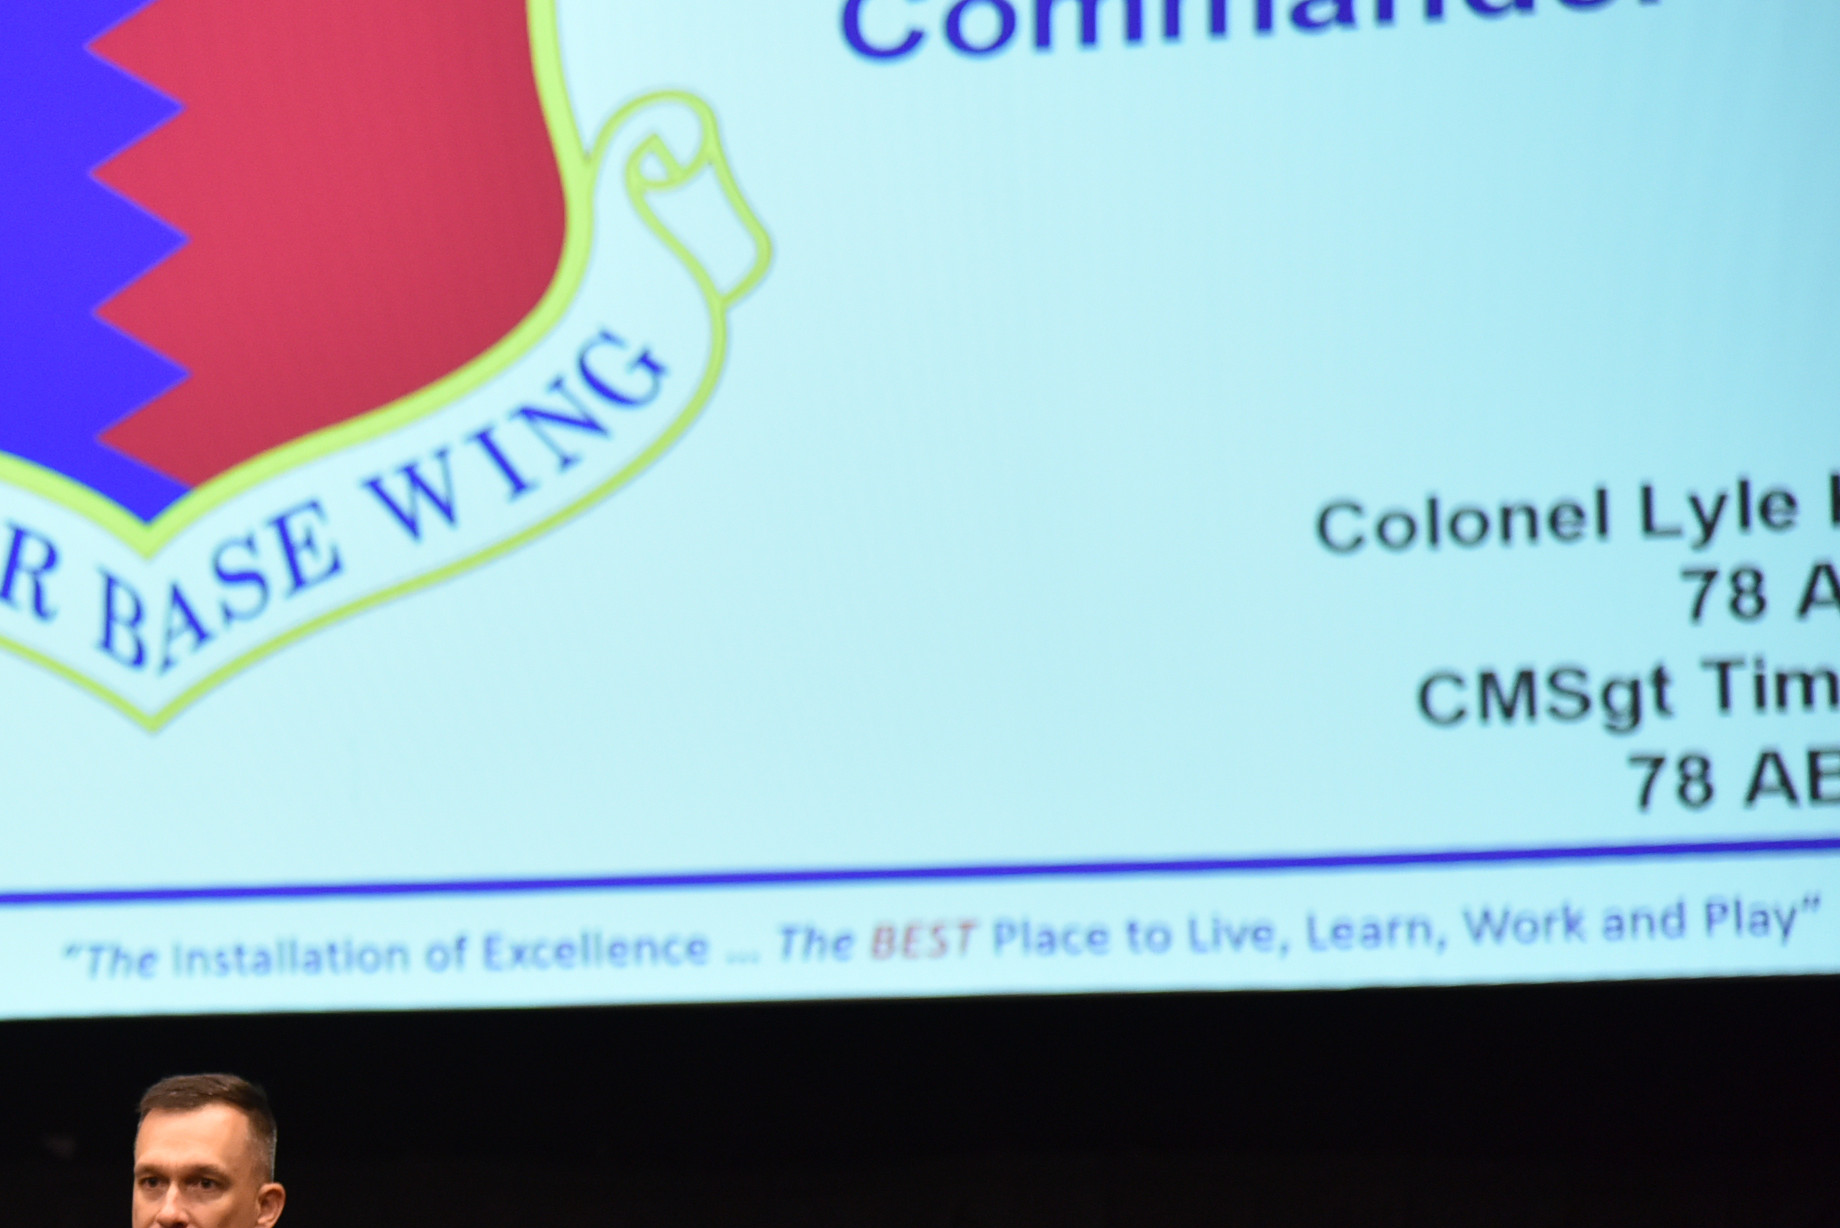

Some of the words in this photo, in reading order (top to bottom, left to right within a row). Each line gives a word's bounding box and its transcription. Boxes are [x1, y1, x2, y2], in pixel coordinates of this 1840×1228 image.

[838, 0, 1662, 65] Comma
[94, 498, 346, 678] BASE
[358, 326, 670, 546] WING
[1315, 484, 1610, 555] Colonel
[1639, 475, 1800, 552] Lyle
[1679, 564, 1768, 624] 78
[1416, 662, 1675, 736] CMSgt
[1699, 655, 1840, 716] Tim
[1626, 750, 1715, 813] 78
[172, 938, 411, 978] Installation
[423, 932, 470, 974] of
[481, 930, 710, 972] Excellence
[779, 922, 857, 963] The
[869, 918, 979, 960] BEST
[992, 918, 1112, 958] Place
[1125, 920, 1173, 955] to
[1187, 916, 1291, 960] Live,
[1305, 914, 1449, 953] Learn,
[1461, 903, 1586, 945] Work
[1601, 898, 1688, 942] and
